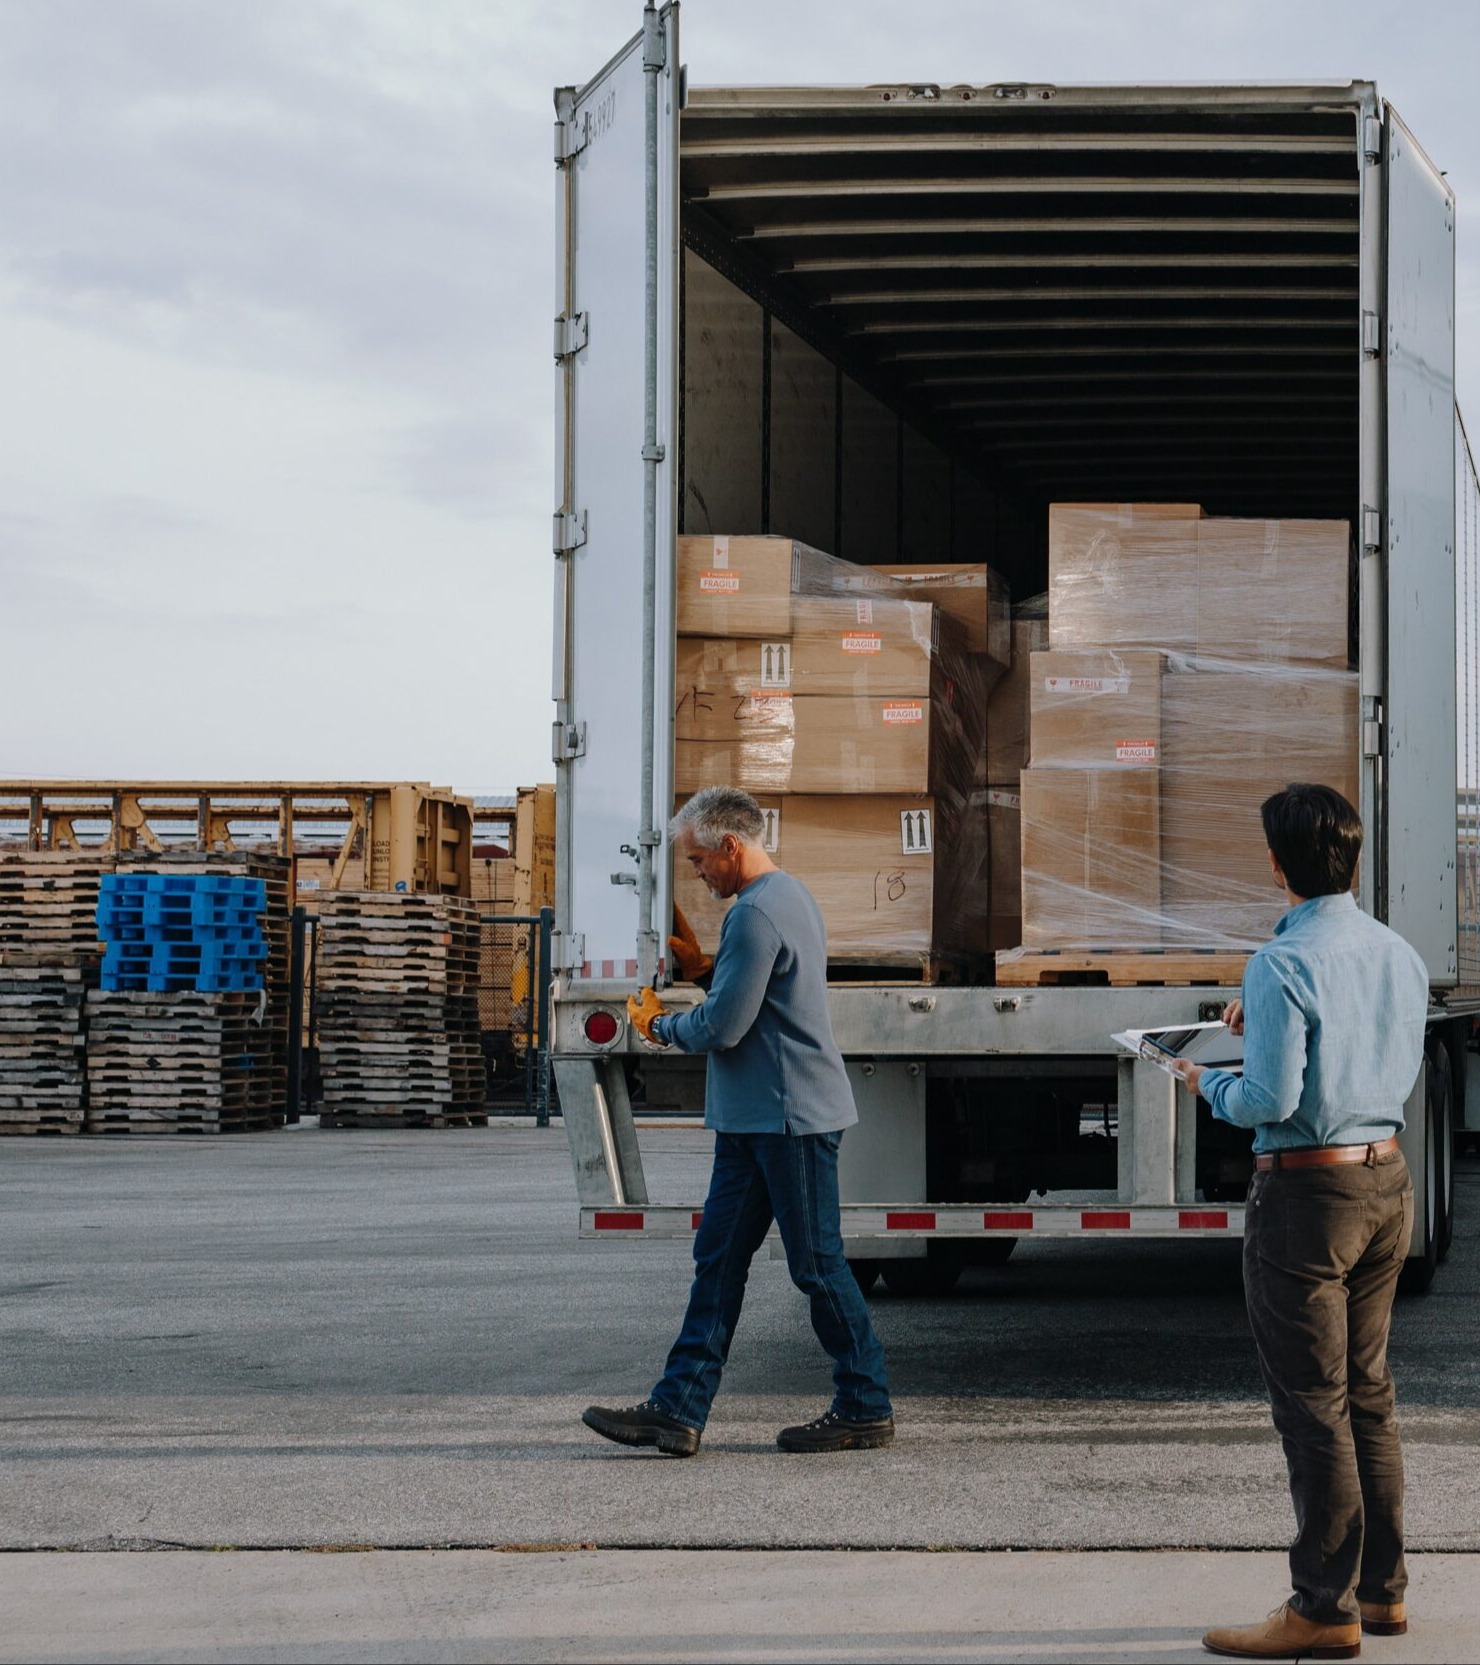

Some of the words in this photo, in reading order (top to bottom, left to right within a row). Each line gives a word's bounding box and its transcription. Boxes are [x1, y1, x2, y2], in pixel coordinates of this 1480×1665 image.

[703, 579, 738, 589] FRAGILE
[845, 640, 880, 649] FRAGILE
[1069, 679, 1103, 689] FRAGILE
[886, 709, 920, 719] FRAGILE
[1120, 748, 1153, 758] FRAGILE
[873, 870, 906, 911] 18
